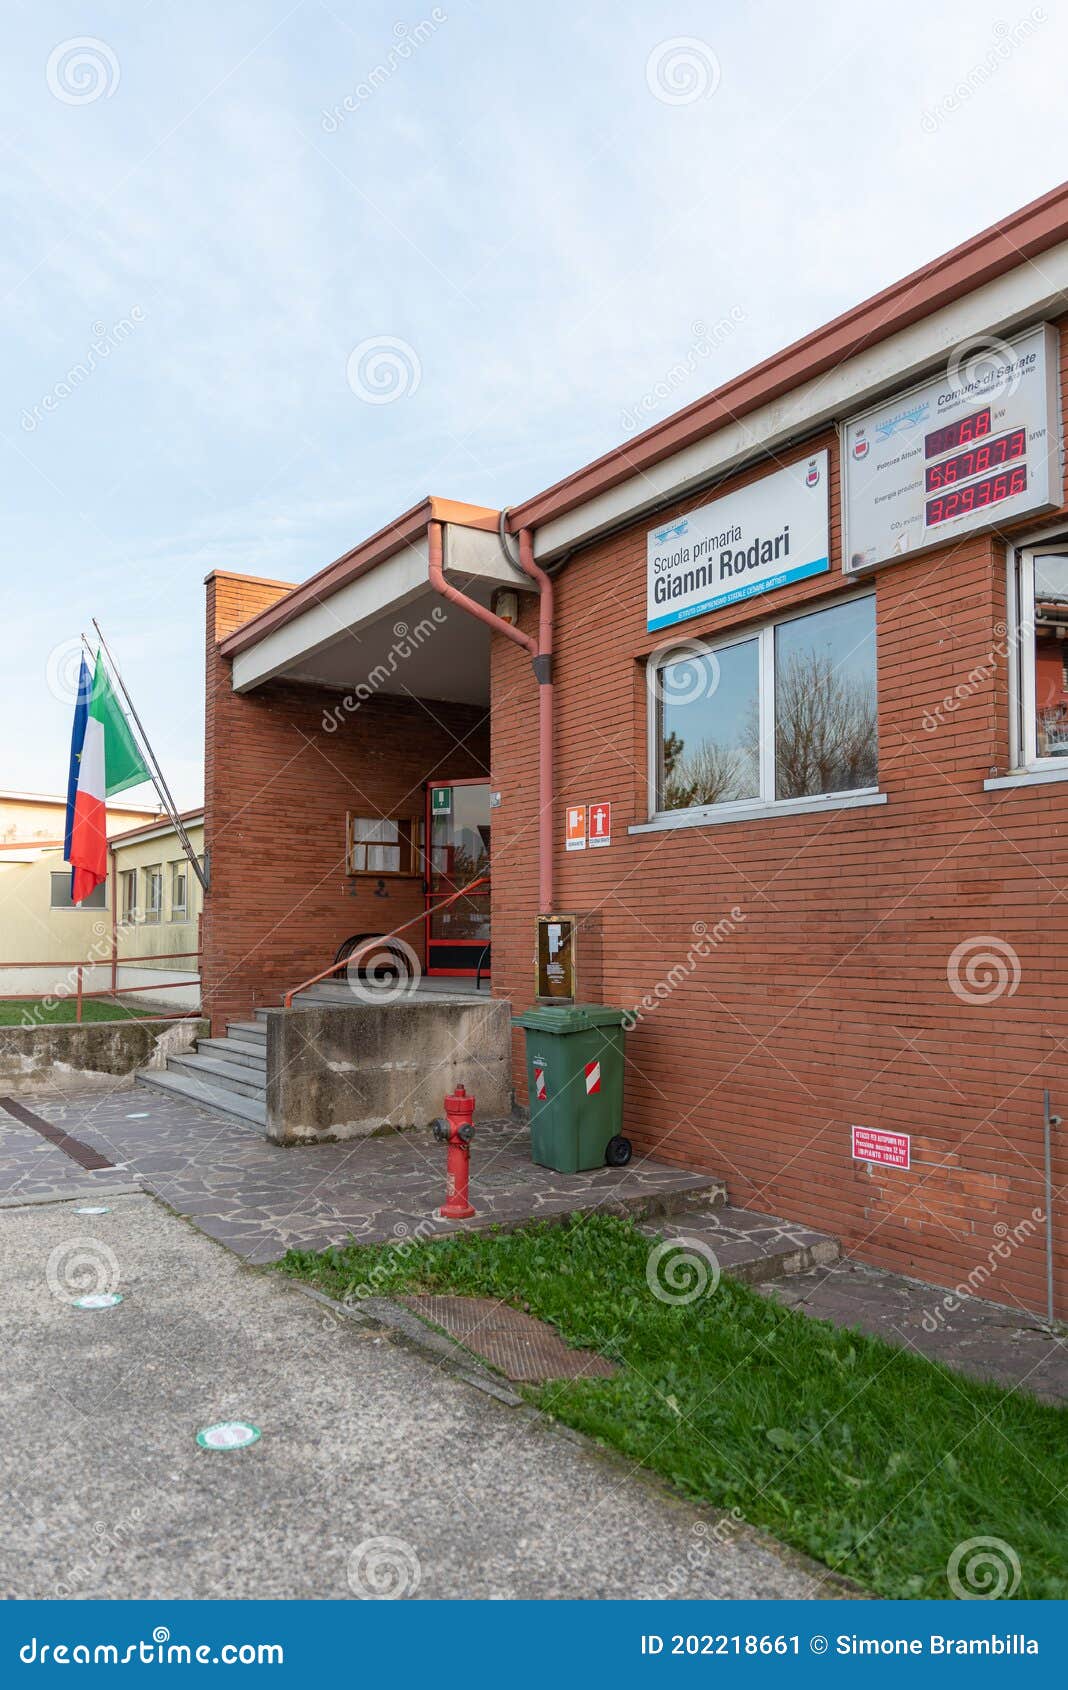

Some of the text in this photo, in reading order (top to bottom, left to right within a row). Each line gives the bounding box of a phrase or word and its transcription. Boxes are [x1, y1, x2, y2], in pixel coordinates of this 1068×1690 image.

[996, 353, 1037, 378] Seriate
[653, 546, 690, 575] Scuola
[693, 524, 742, 562] primaria
[653, 525, 790, 605] Gianni Rodari
